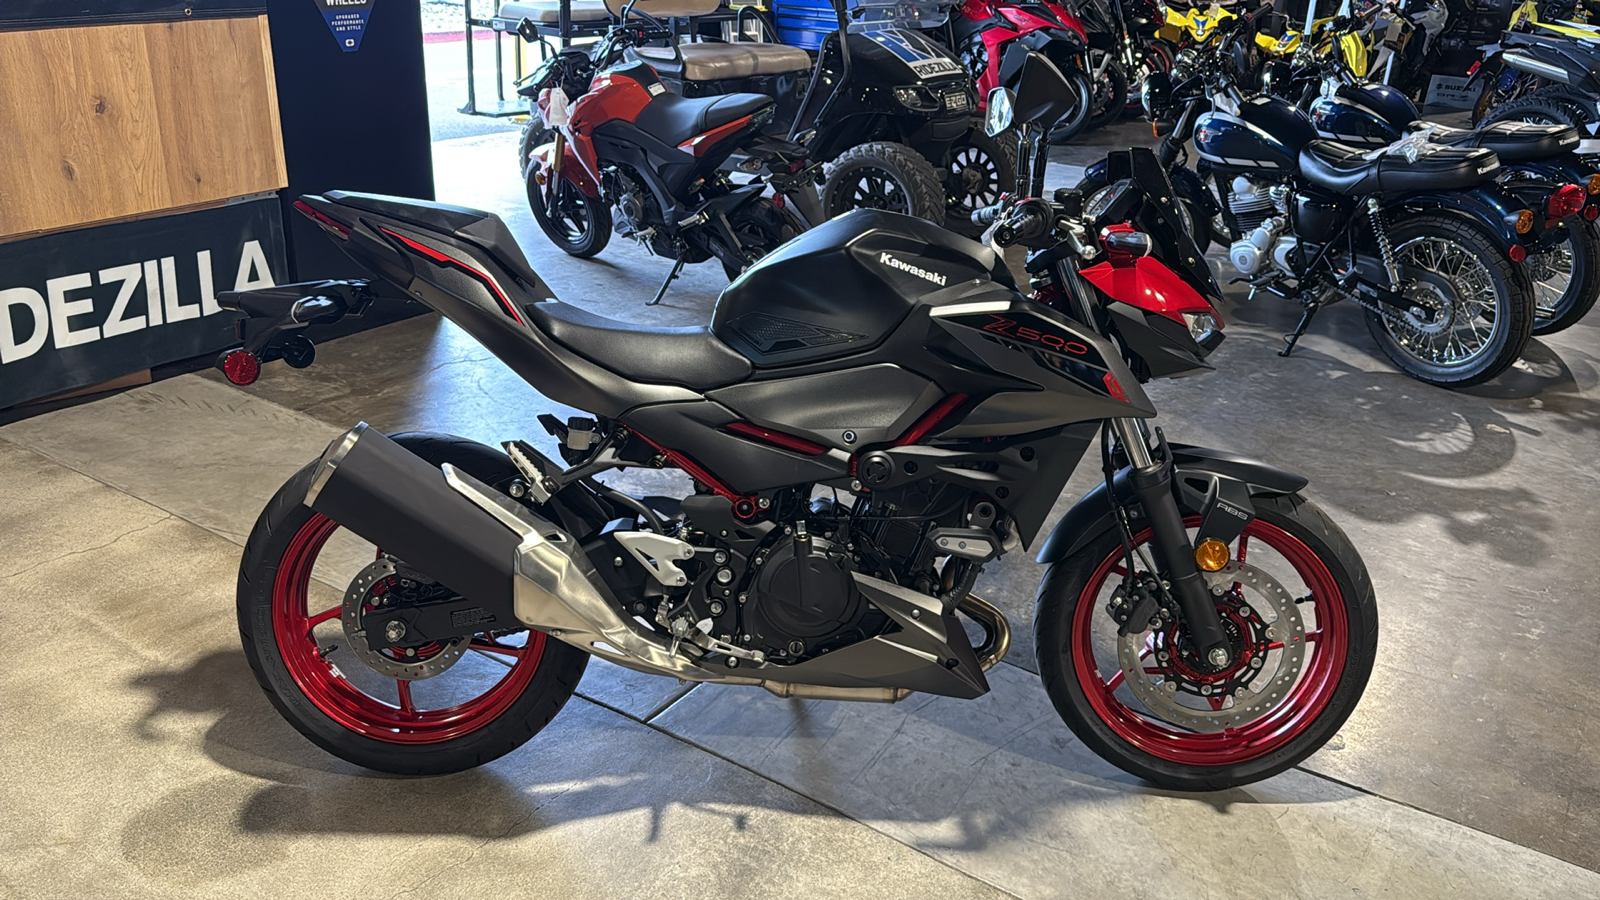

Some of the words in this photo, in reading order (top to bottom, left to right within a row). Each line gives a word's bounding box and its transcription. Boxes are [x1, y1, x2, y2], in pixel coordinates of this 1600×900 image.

[913, 61, 961, 77] RIDEZILLA
[1444, 84, 1476, 92] SUZKI
[880, 252, 947, 286] Kawasaki
[1217, 502, 1248, 520] ABS
